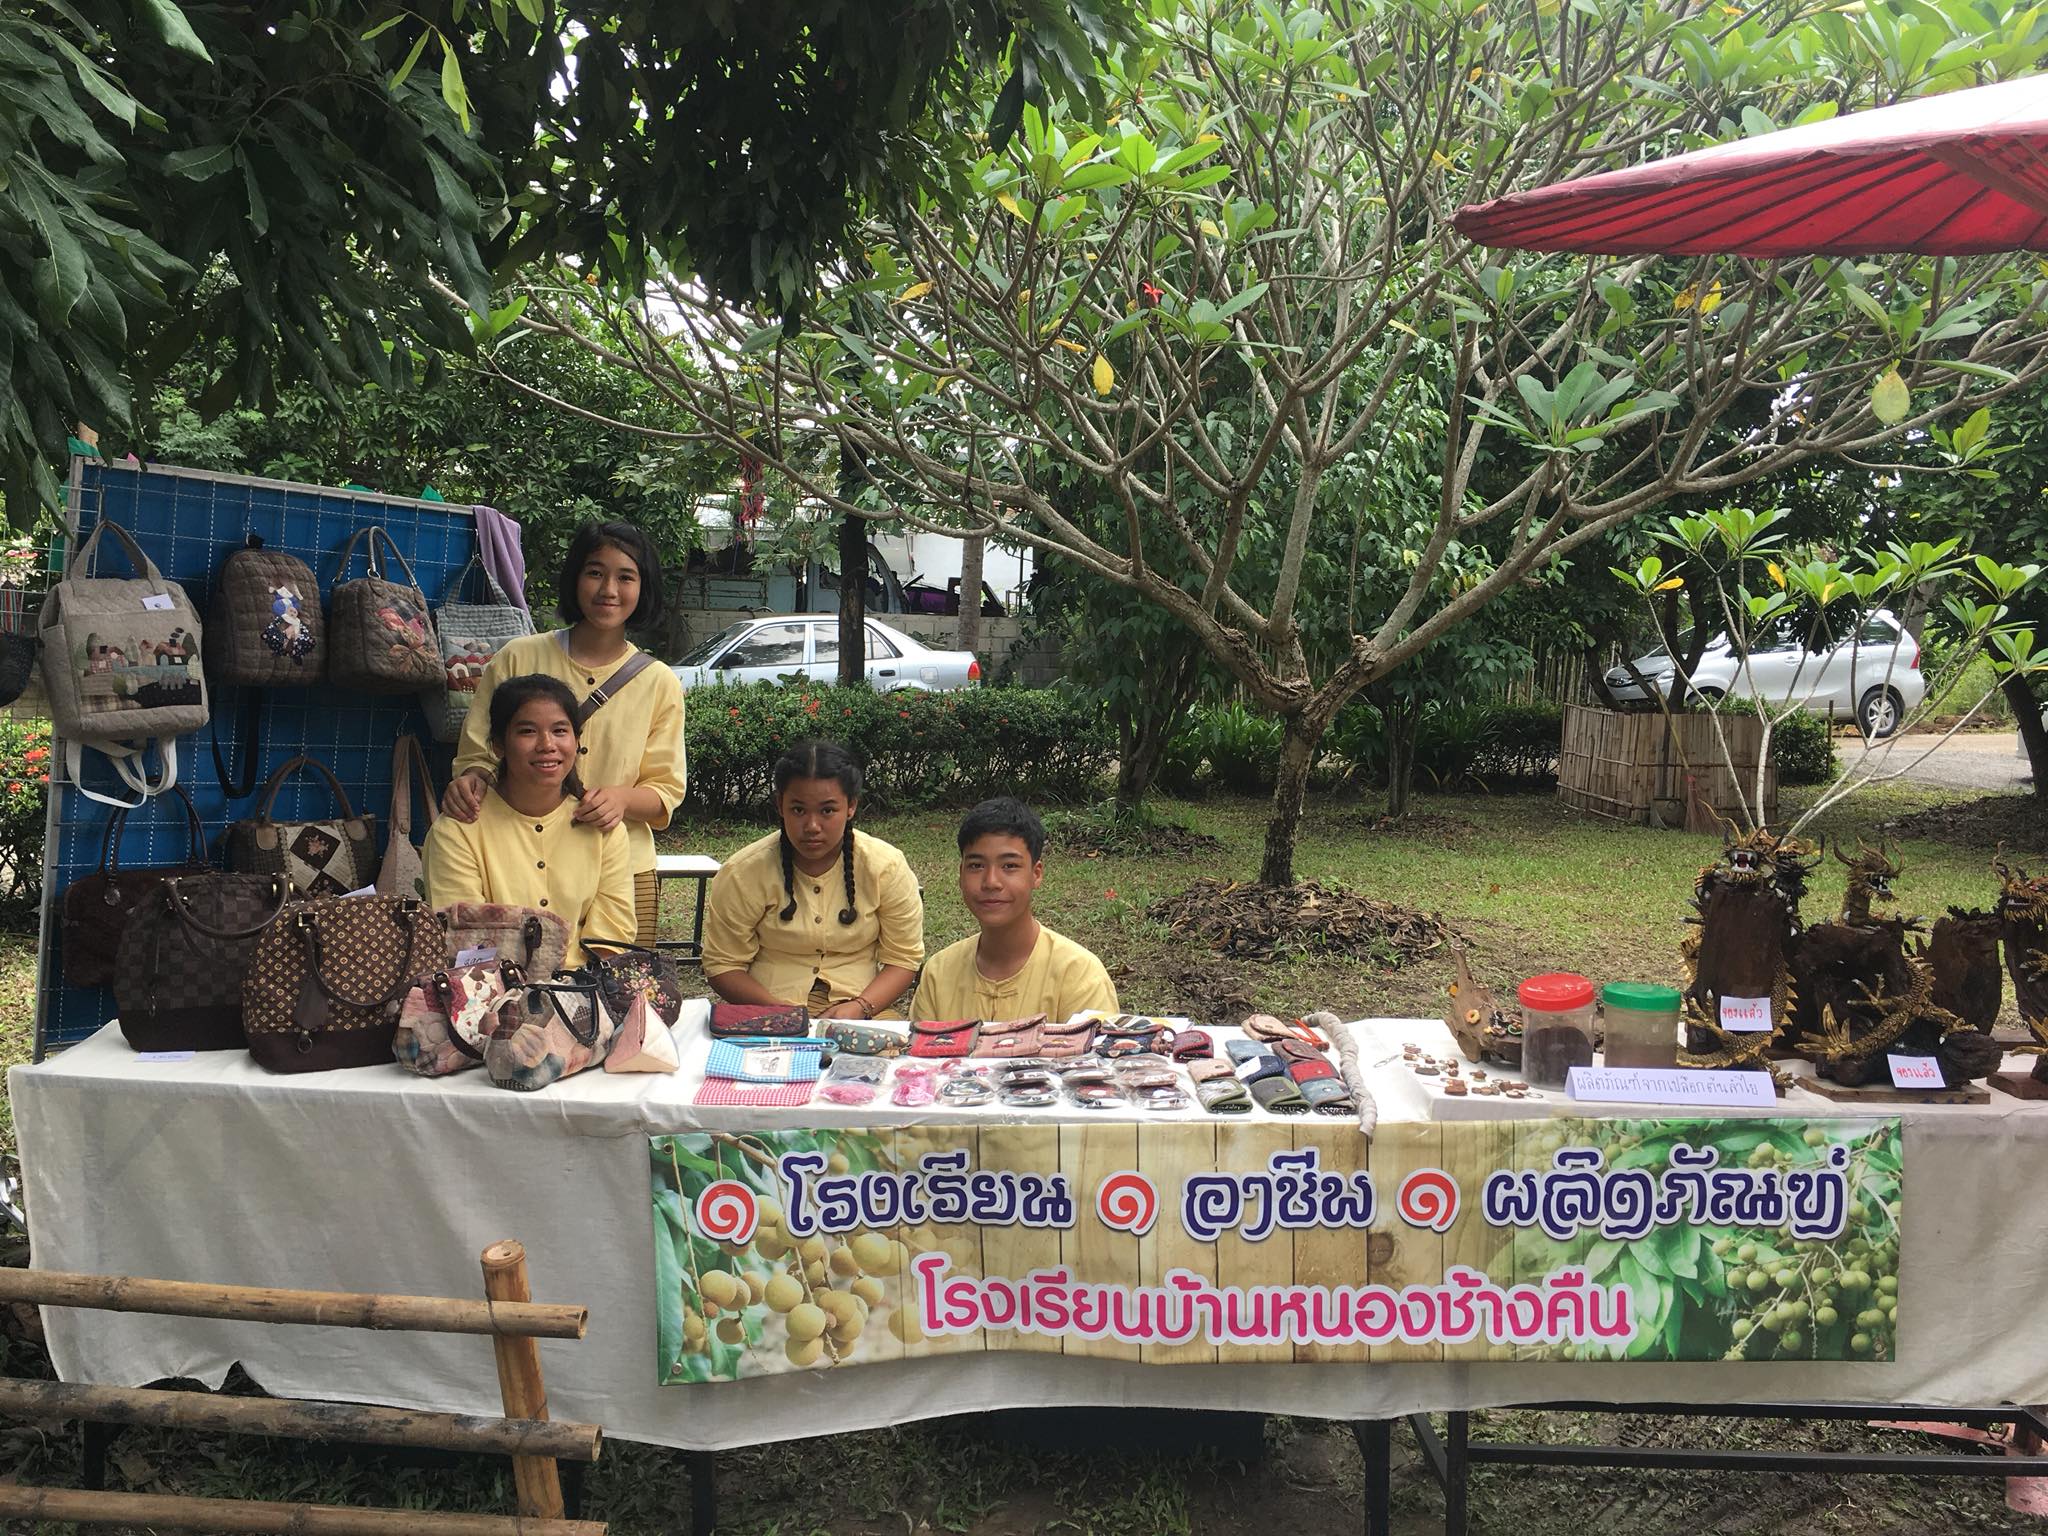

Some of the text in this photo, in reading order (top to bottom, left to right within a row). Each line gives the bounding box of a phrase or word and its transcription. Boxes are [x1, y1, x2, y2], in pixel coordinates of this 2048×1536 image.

[780, 1150, 1073, 1235] โรงเรียน
[1185, 1147, 1373, 1240] อาชีพ
[1485, 1145, 1849, 1239] ผลิตภัณฑ์
[916, 1256, 1635, 1344] โรงเรียนบ้านหนองช้างคืน
